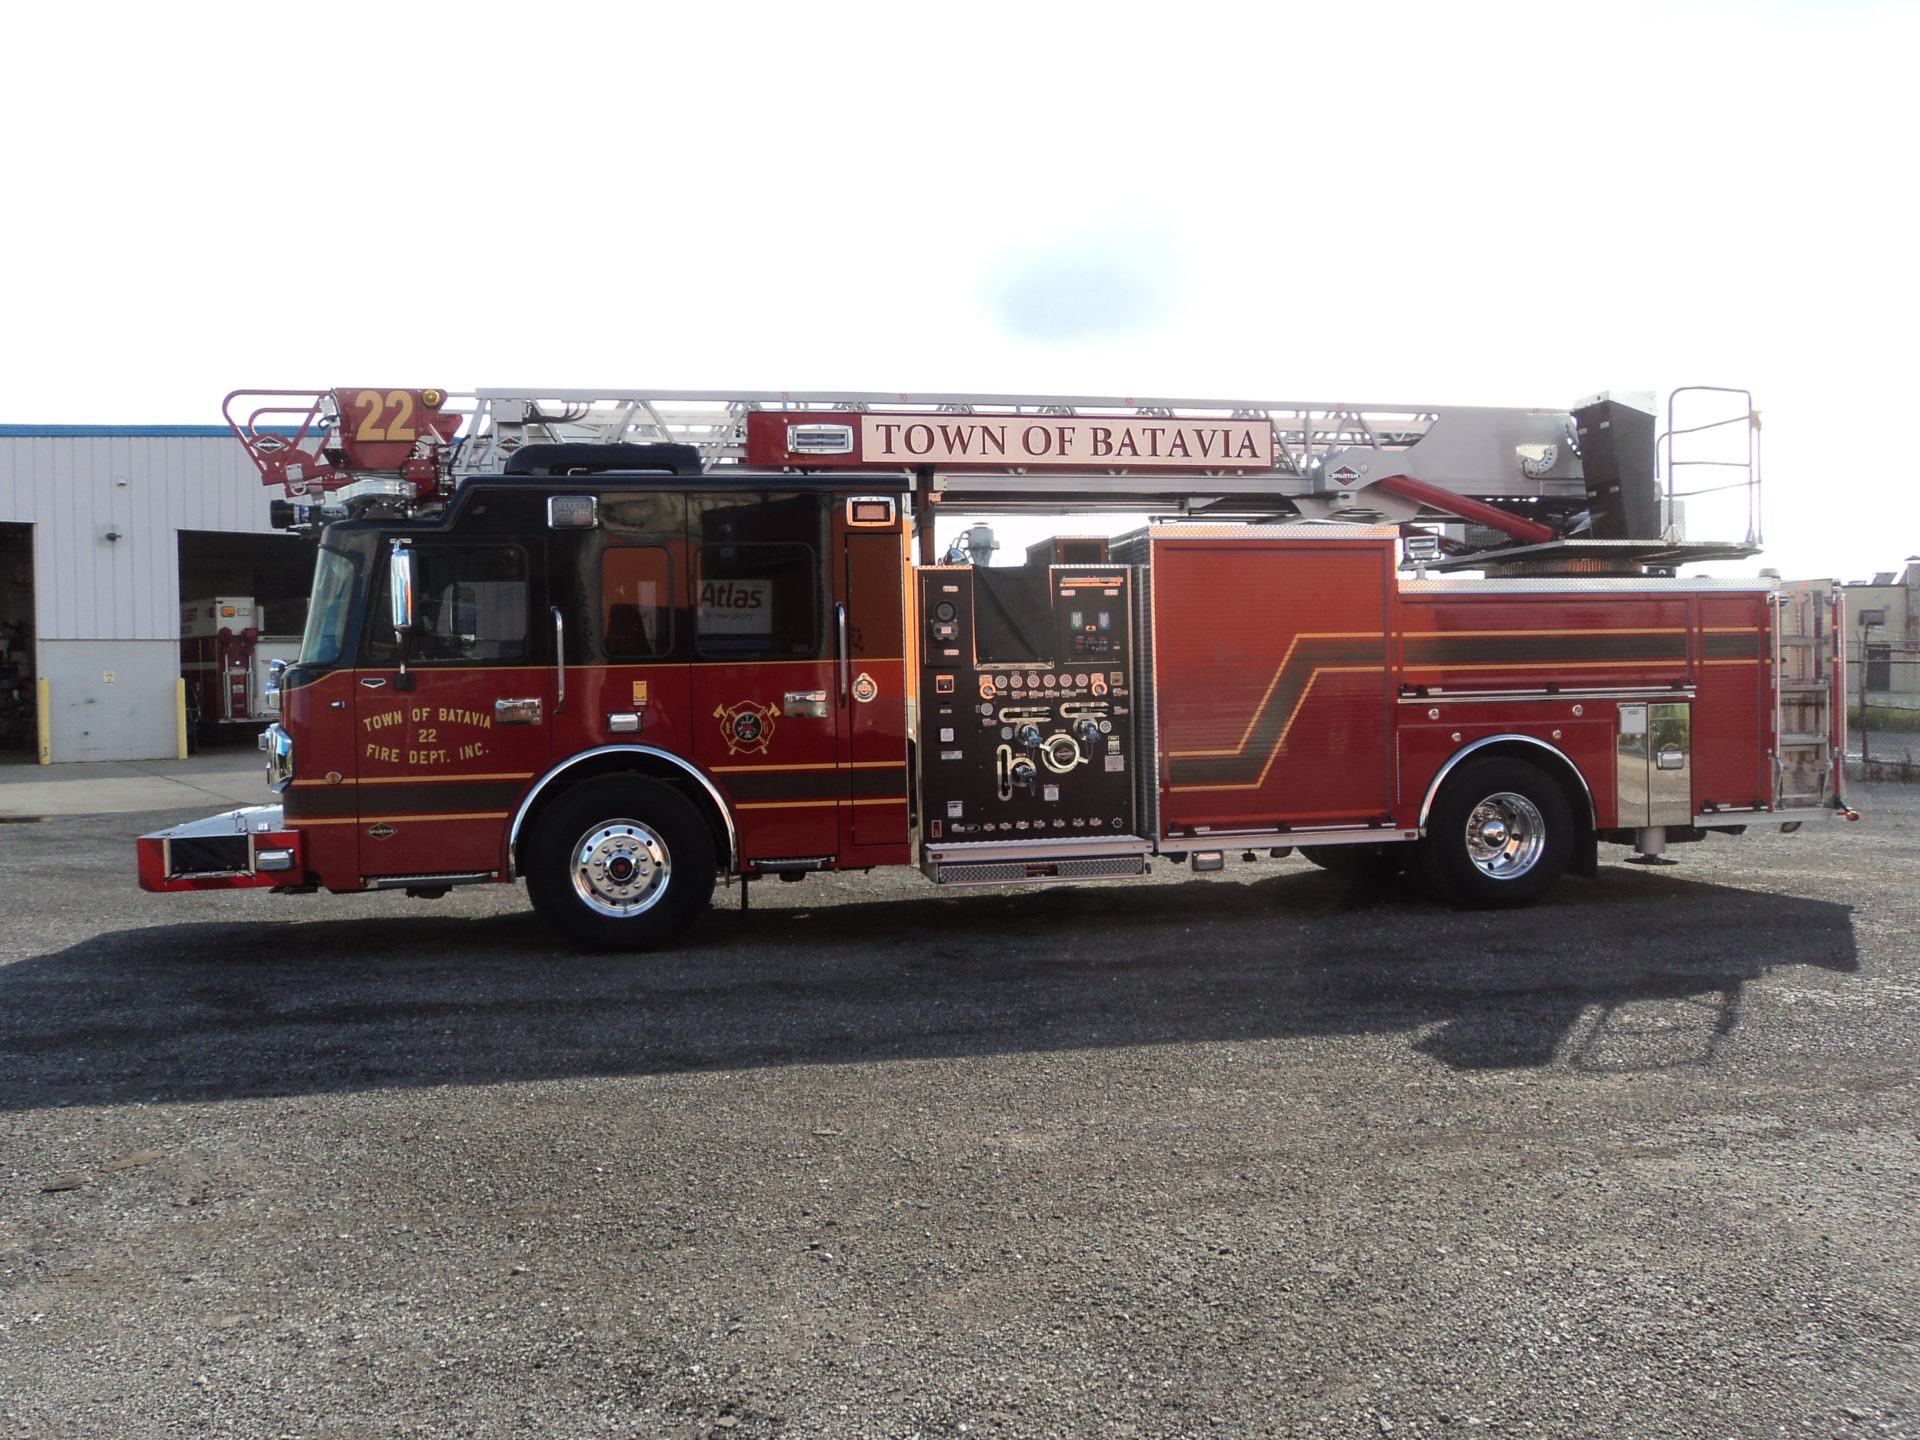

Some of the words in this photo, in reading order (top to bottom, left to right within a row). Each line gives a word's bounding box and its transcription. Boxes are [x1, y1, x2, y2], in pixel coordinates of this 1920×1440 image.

[355, 390, 415, 441] 22
[876, 424, 1007, 455] TOWN
[1022, 425, 1076, 456] OF
[1089, 427, 1261, 459] BATAVIA
[702, 582, 763, 609] Atlas
[364, 711, 401, 731] TOWN
[412, 708, 430, 721] OF
[439, 708, 490, 728] BATAVIA
[419, 729, 436, 742] 22
[366, 744, 399, 762] FIRE
[409, 750, 450, 763] DEPT.
[459, 743, 488, 759] INC.
